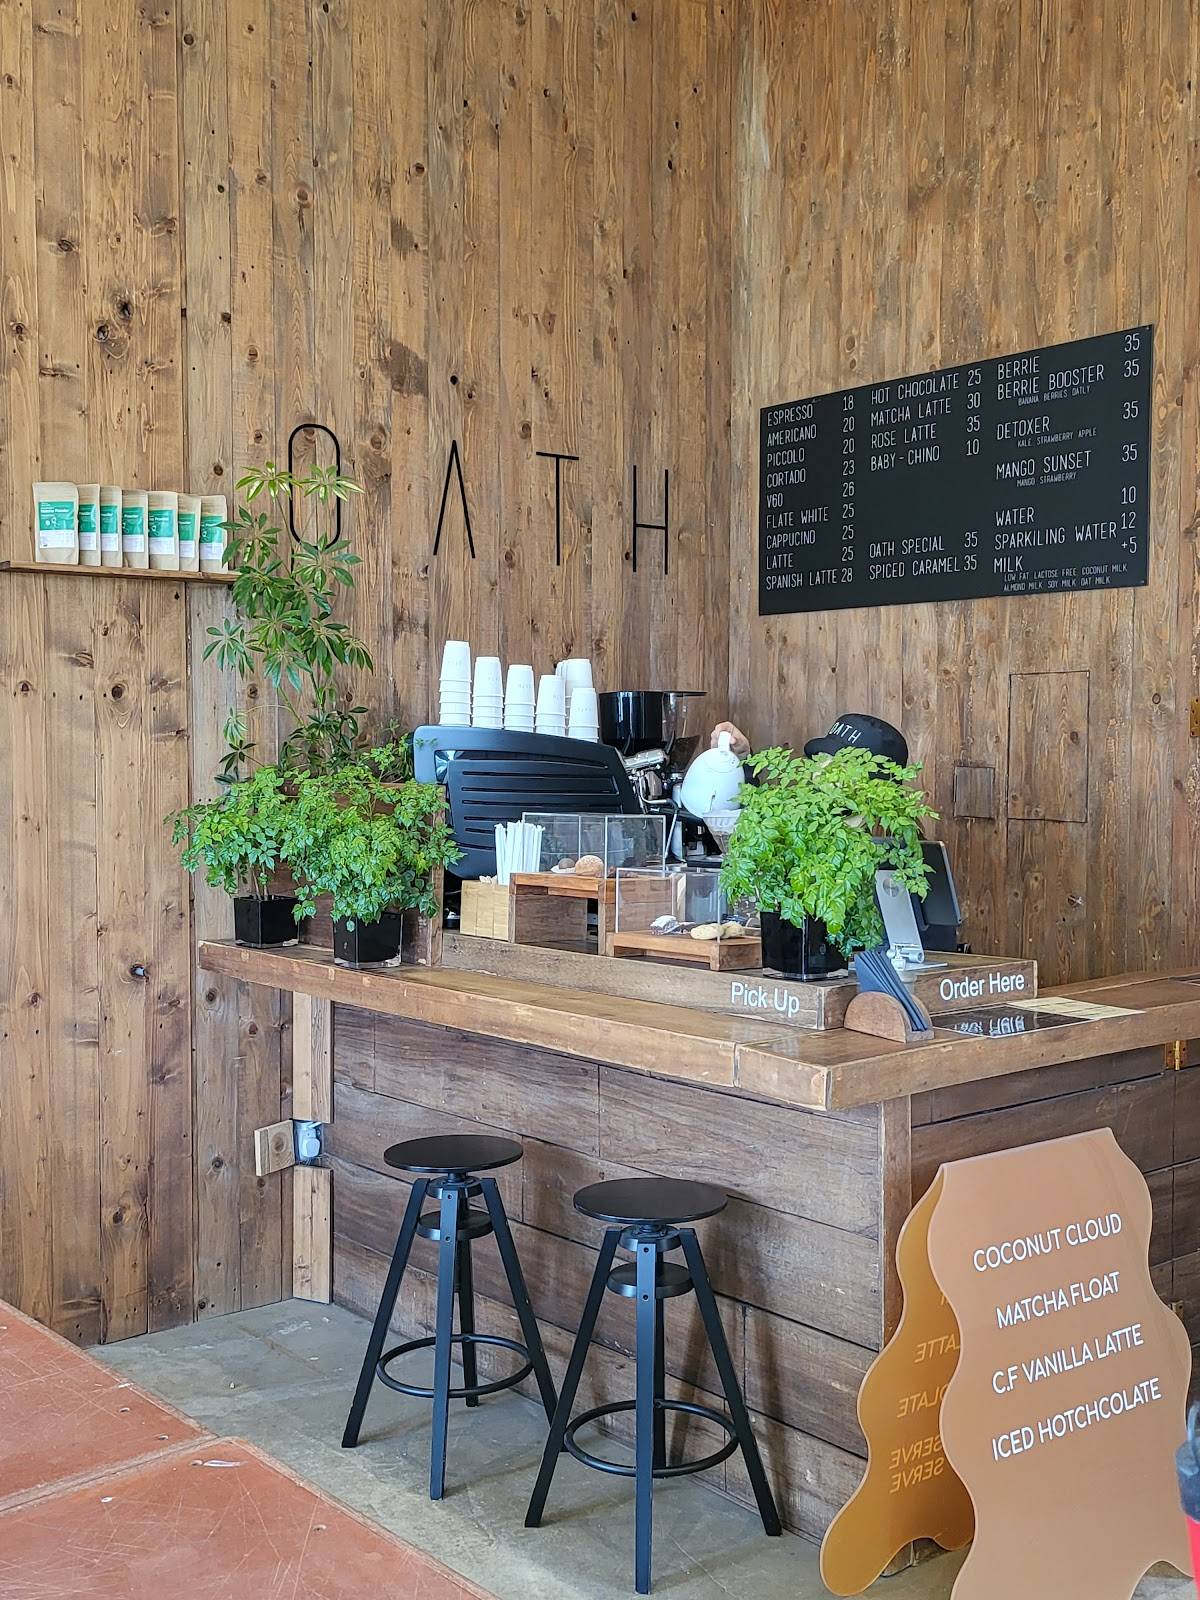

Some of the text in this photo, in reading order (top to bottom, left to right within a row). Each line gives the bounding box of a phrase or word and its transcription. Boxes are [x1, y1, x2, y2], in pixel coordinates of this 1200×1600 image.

[997, 333, 1140, 380] BERRIE 35
[871, 368, 981, 405] HOT CHOCOLATE 25
[997, 358, 1140, 400] BERRIE BOOSTER 35
[1043, 389, 1068, 402] BERRIES
[1071, 385, 1090, 396] OATLY
[767, 395, 854, 426] ESPRESSO 18
[870, 392, 981, 427] MATCHA LATTE 30
[996, 401, 1139, 440] DETOXER 35
[767, 416, 855, 447] AMERICANO 20
[871, 415, 981, 449] ROSE LATTE 35
[1017, 427, 1097, 448] KALE STRAWBERRY APPLE
[767, 438, 855, 468] PICCOLO 20
[966, 439, 980, 456] 10
[996, 444, 1138, 480] MANGO SUNSET 35
[767, 459, 855, 488] CORTADO 23
[1016, 472, 1077, 488] MANGO STRAWBERRY
[767, 481, 855, 508] V60 26
[996, 485, 1137, 527] WATER 10
[767, 503, 855, 529] FLATE WHITE 25
[995, 511, 1136, 551] SPARKILING WATER 12
[766, 524, 855, 550] CAPPUCINO 25
[869, 531, 978, 559] OATH SPECIAL 35
[766, 546, 854, 570] LATTE 25
[869, 554, 977, 580] SPICED CARAMEL 35
[993, 536, 1137, 574] MILK +5
[766, 567, 853, 591] SPANISH LATTE 28
[1003, 575, 1110, 592] ALMOND MILK SOY MILK OAT MILK
[1004, 563, 1128, 582] LOW FAT LACTOSE FREE COCONUT MILK
[829, 722, 861, 744] OATH
[731, 981, 800, 1018] Pick Up
[940, 972, 1025, 1000] Order Here
[973, 1212, 1122, 1272] COCONUT CLOUD
[996, 1271, 1120, 1329] MATCHA FLOAT
[992, 1323, 1144, 1394] C.F VANILLA LATTE
[992, 1377, 1162, 1461] ICED HOTCHCOLATE
